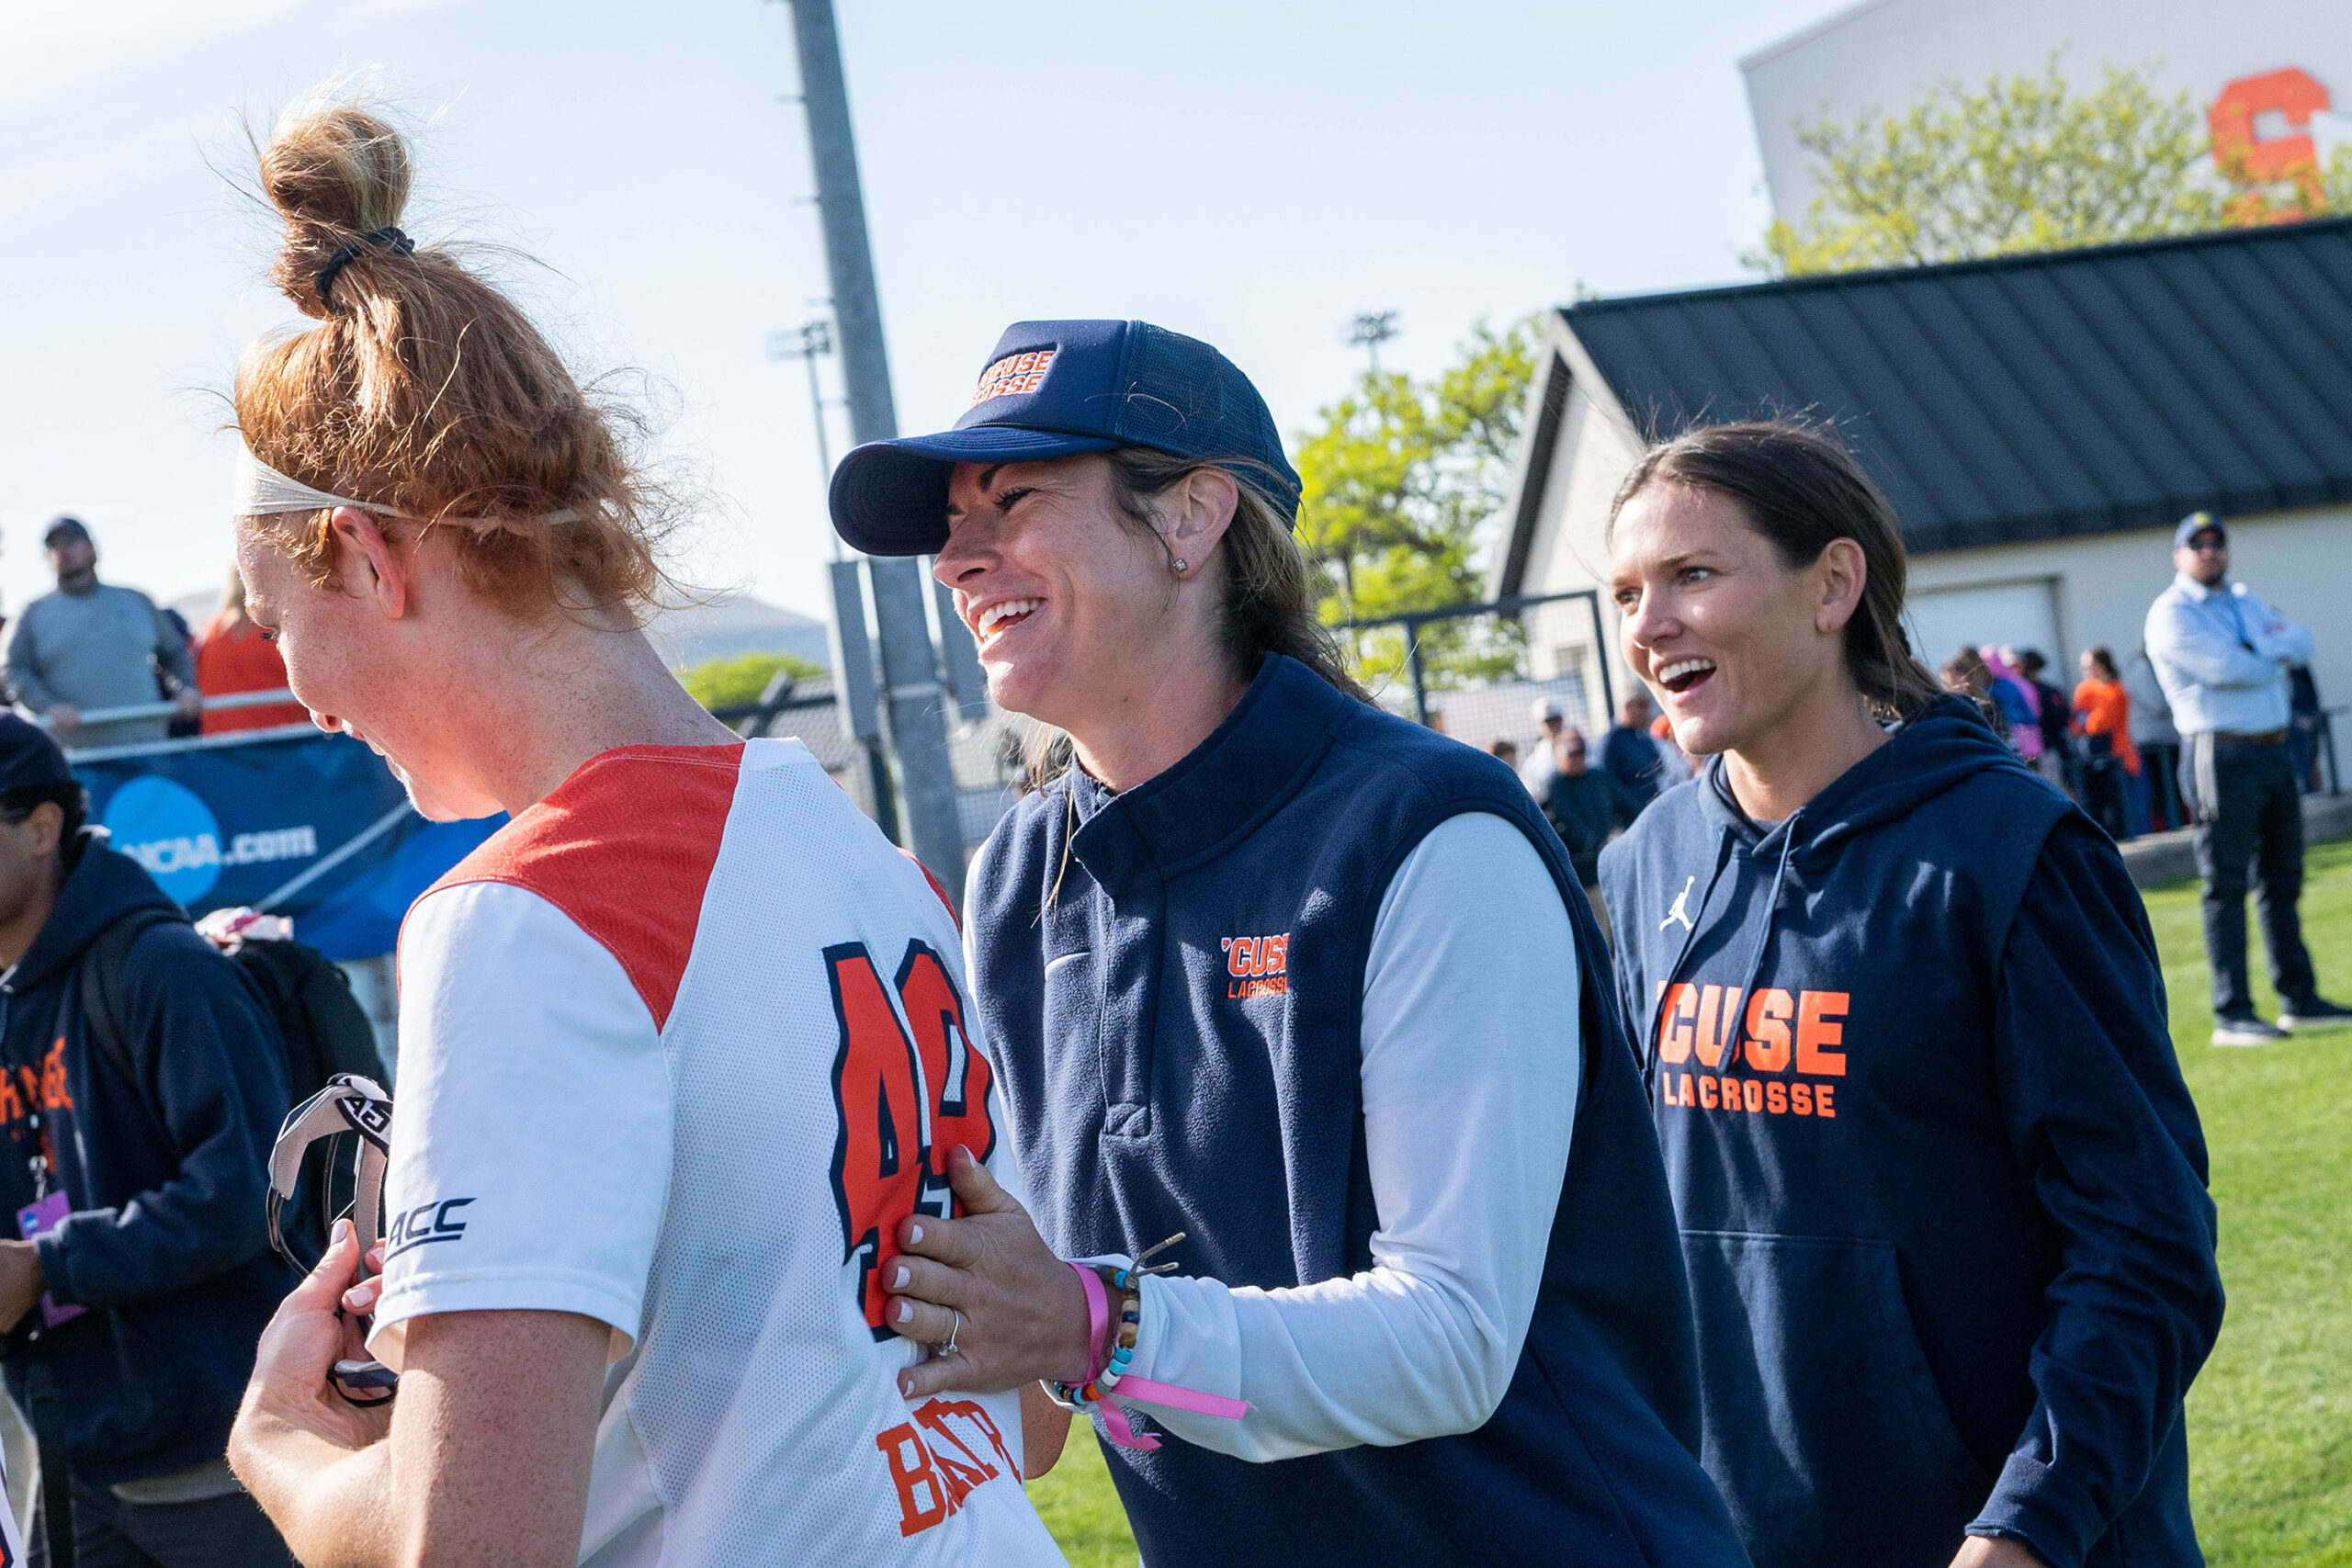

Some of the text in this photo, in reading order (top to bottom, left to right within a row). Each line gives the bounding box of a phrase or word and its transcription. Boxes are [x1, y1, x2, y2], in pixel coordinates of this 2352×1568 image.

[1657, 980, 1849, 1076] 'CUSE
[1662, 1071, 1836, 1117] LACROSSE
[389, 1198, 478, 1247] ACC
